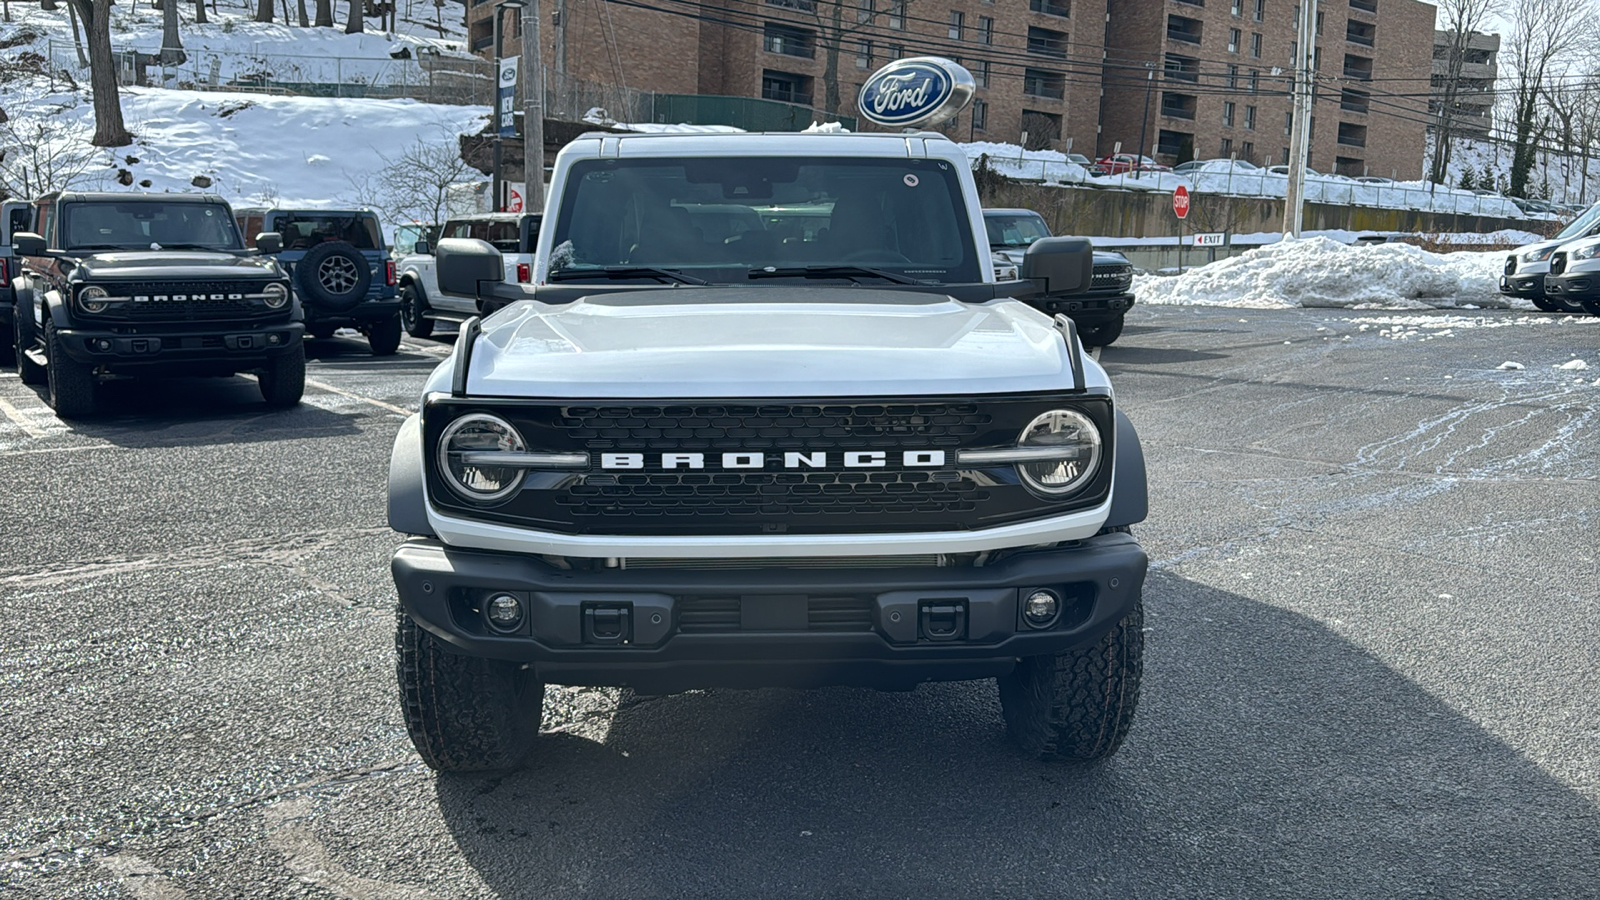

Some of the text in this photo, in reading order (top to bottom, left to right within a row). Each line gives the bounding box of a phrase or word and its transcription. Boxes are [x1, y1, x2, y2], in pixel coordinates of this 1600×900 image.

[874, 72, 930, 113] Ford
[502, 96, 514, 113] NEW
[501, 112, 514, 127] CARS
[1175, 195, 1188, 208] STOP
[1204, 235, 1221, 244] EXIT
[601, 450, 945, 469] BRONCO
